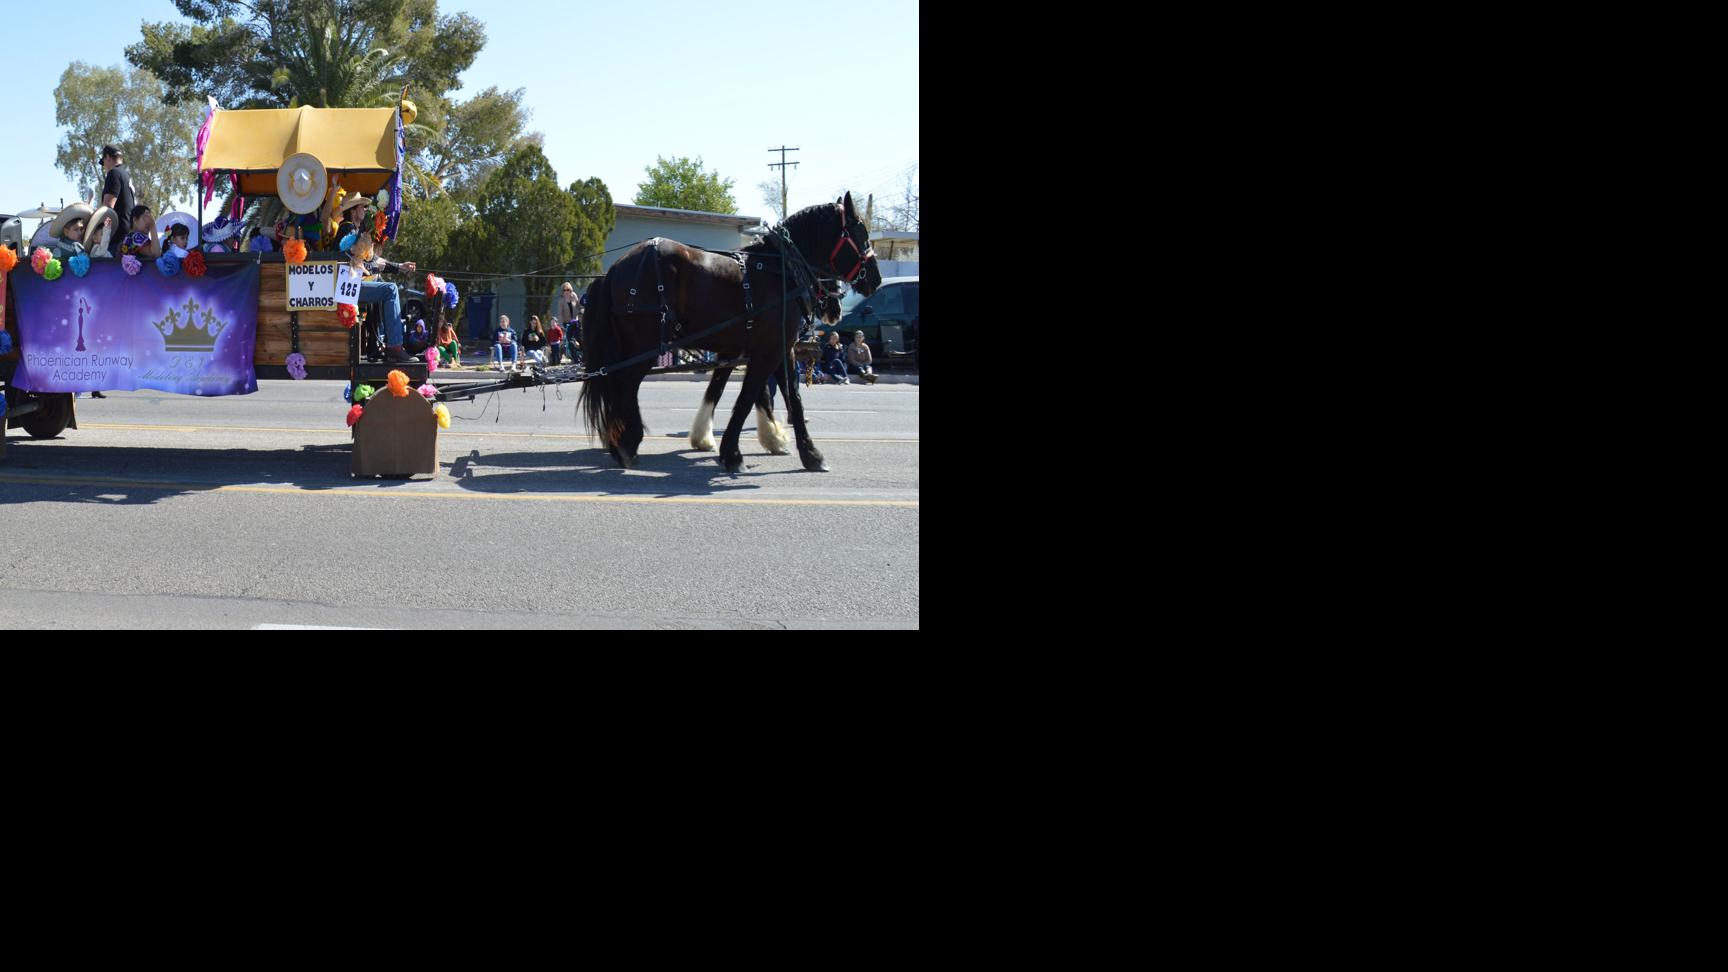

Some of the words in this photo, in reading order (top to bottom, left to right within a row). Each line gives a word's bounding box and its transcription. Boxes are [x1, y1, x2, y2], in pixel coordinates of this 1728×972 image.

[288, 264, 334, 275] MODELOS
[308, 281, 315, 291] Y
[340, 281, 358, 297] 425
[289, 297, 334, 307] CHARROS
[27, 354, 88, 367] Phoenician
[91, 354, 134, 369] Runway
[52, 369, 107, 383] Academy
